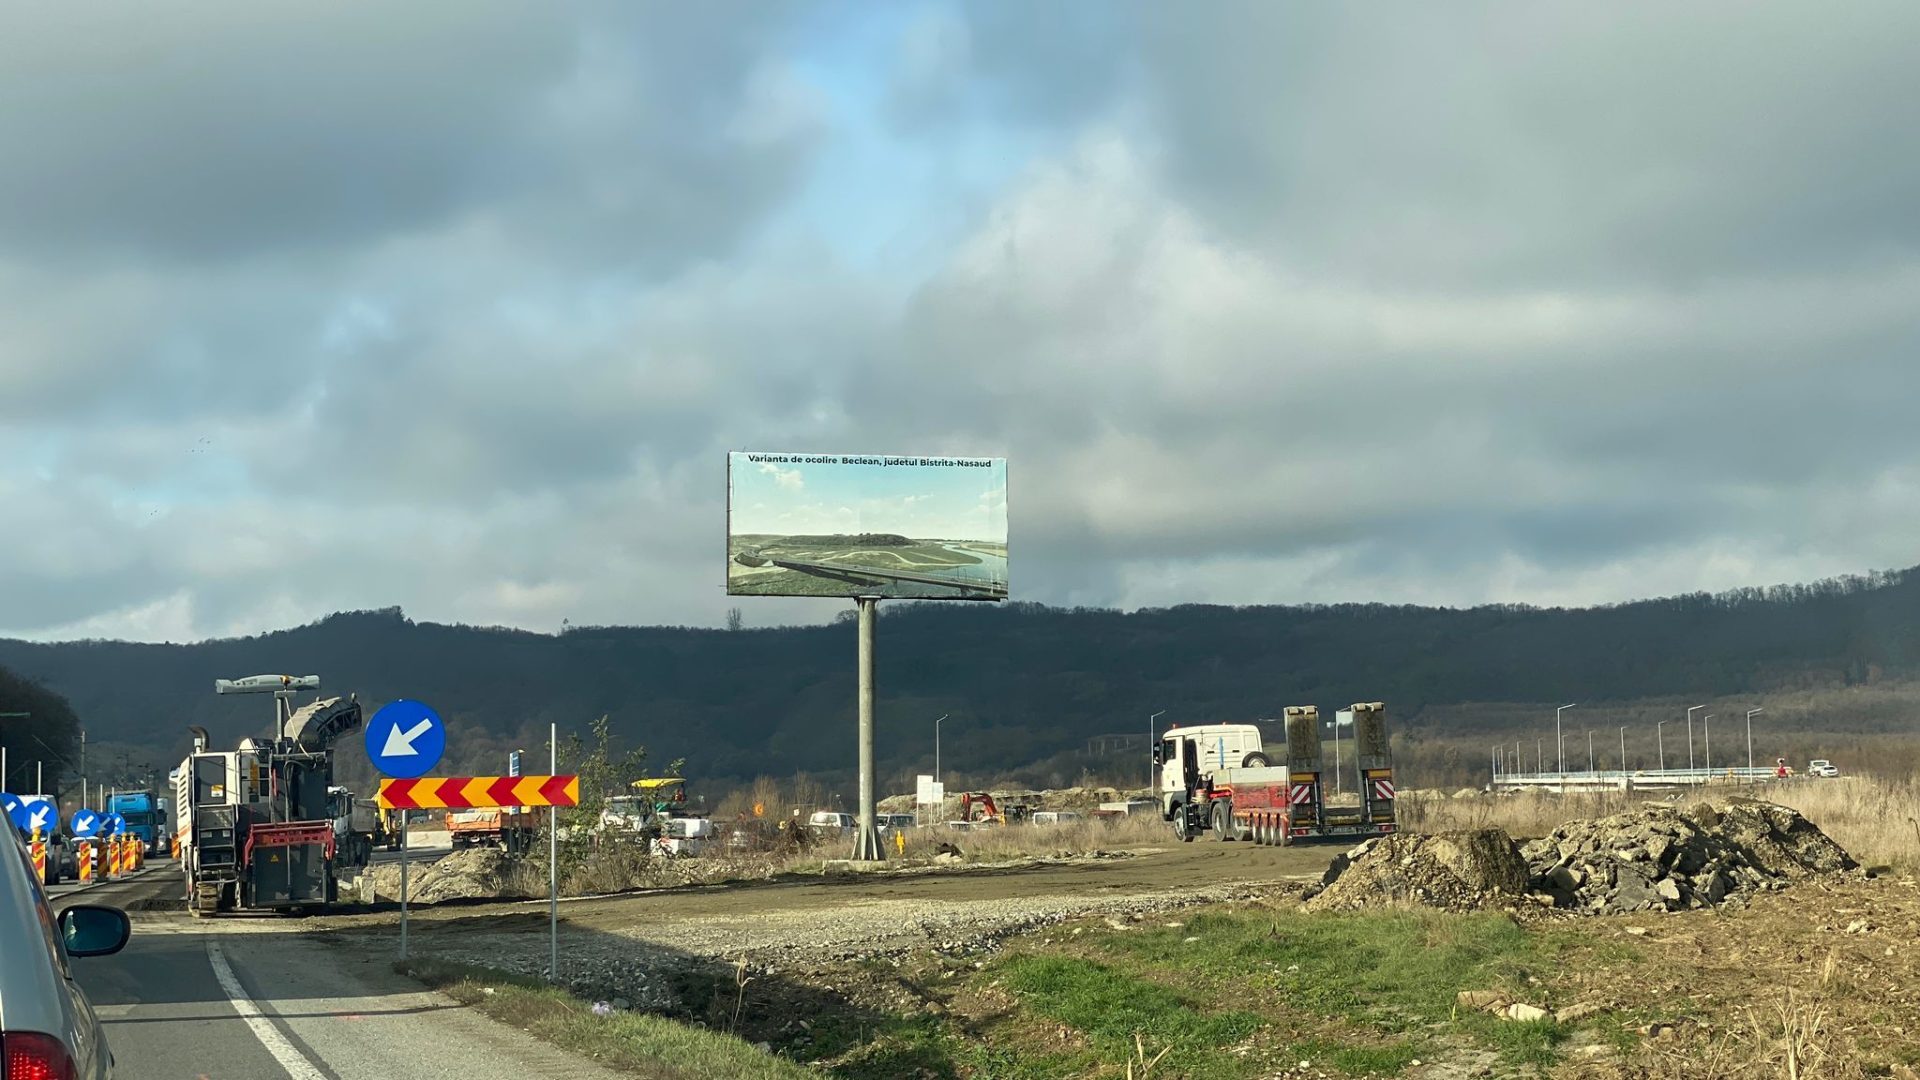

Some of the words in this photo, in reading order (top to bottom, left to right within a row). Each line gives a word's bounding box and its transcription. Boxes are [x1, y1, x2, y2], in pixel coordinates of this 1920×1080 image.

[748, 454, 788, 463] Varianta
[790, 455, 803, 463] de
[805, 456, 838, 464] ocolire
[842, 457, 882, 466] Beclean,
[884, 458, 918, 467] judetul
[920, 459, 992, 468] Bistrita-Nasaud
